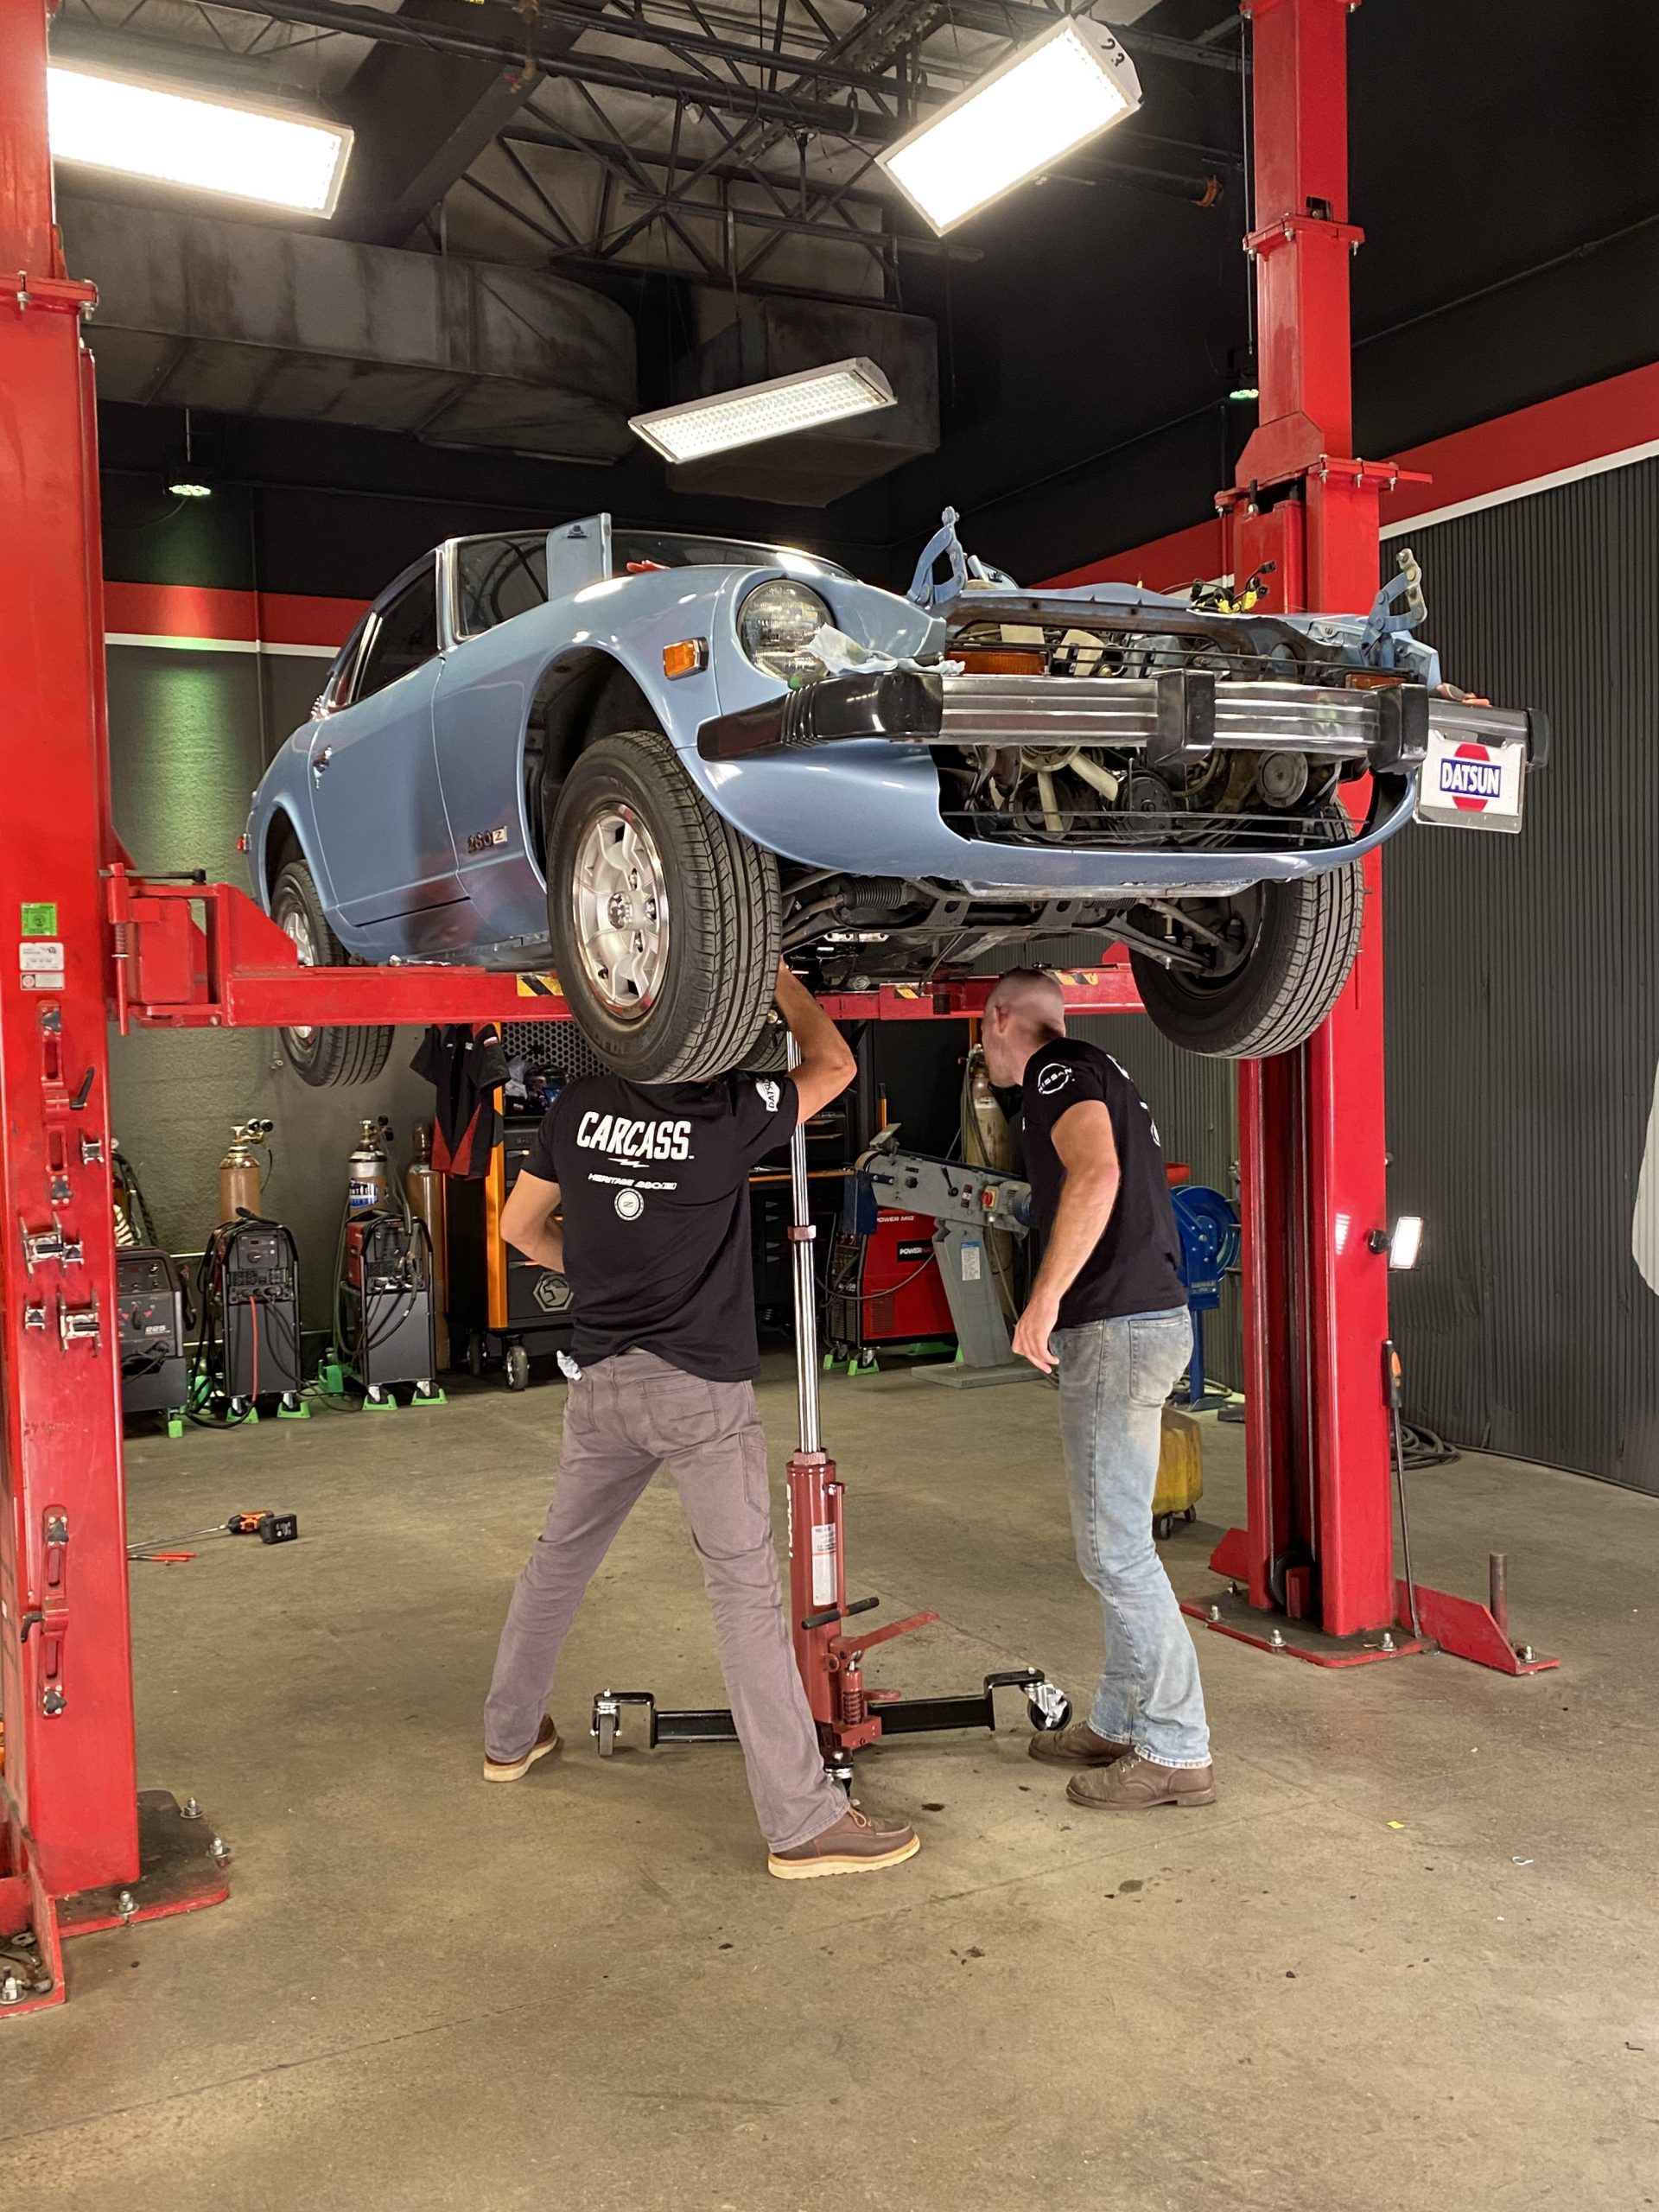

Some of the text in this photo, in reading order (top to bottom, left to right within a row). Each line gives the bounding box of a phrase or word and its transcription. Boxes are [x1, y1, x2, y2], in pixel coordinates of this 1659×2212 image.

[1441, 762, 1500, 795] DATSUN
[763, 1079, 775, 1109] DATSU
[1039, 1067, 1072, 1093] NISSAN
[576, 1111, 691, 1160] CARCASS
[588, 1173, 634, 1186] HERITAGE
